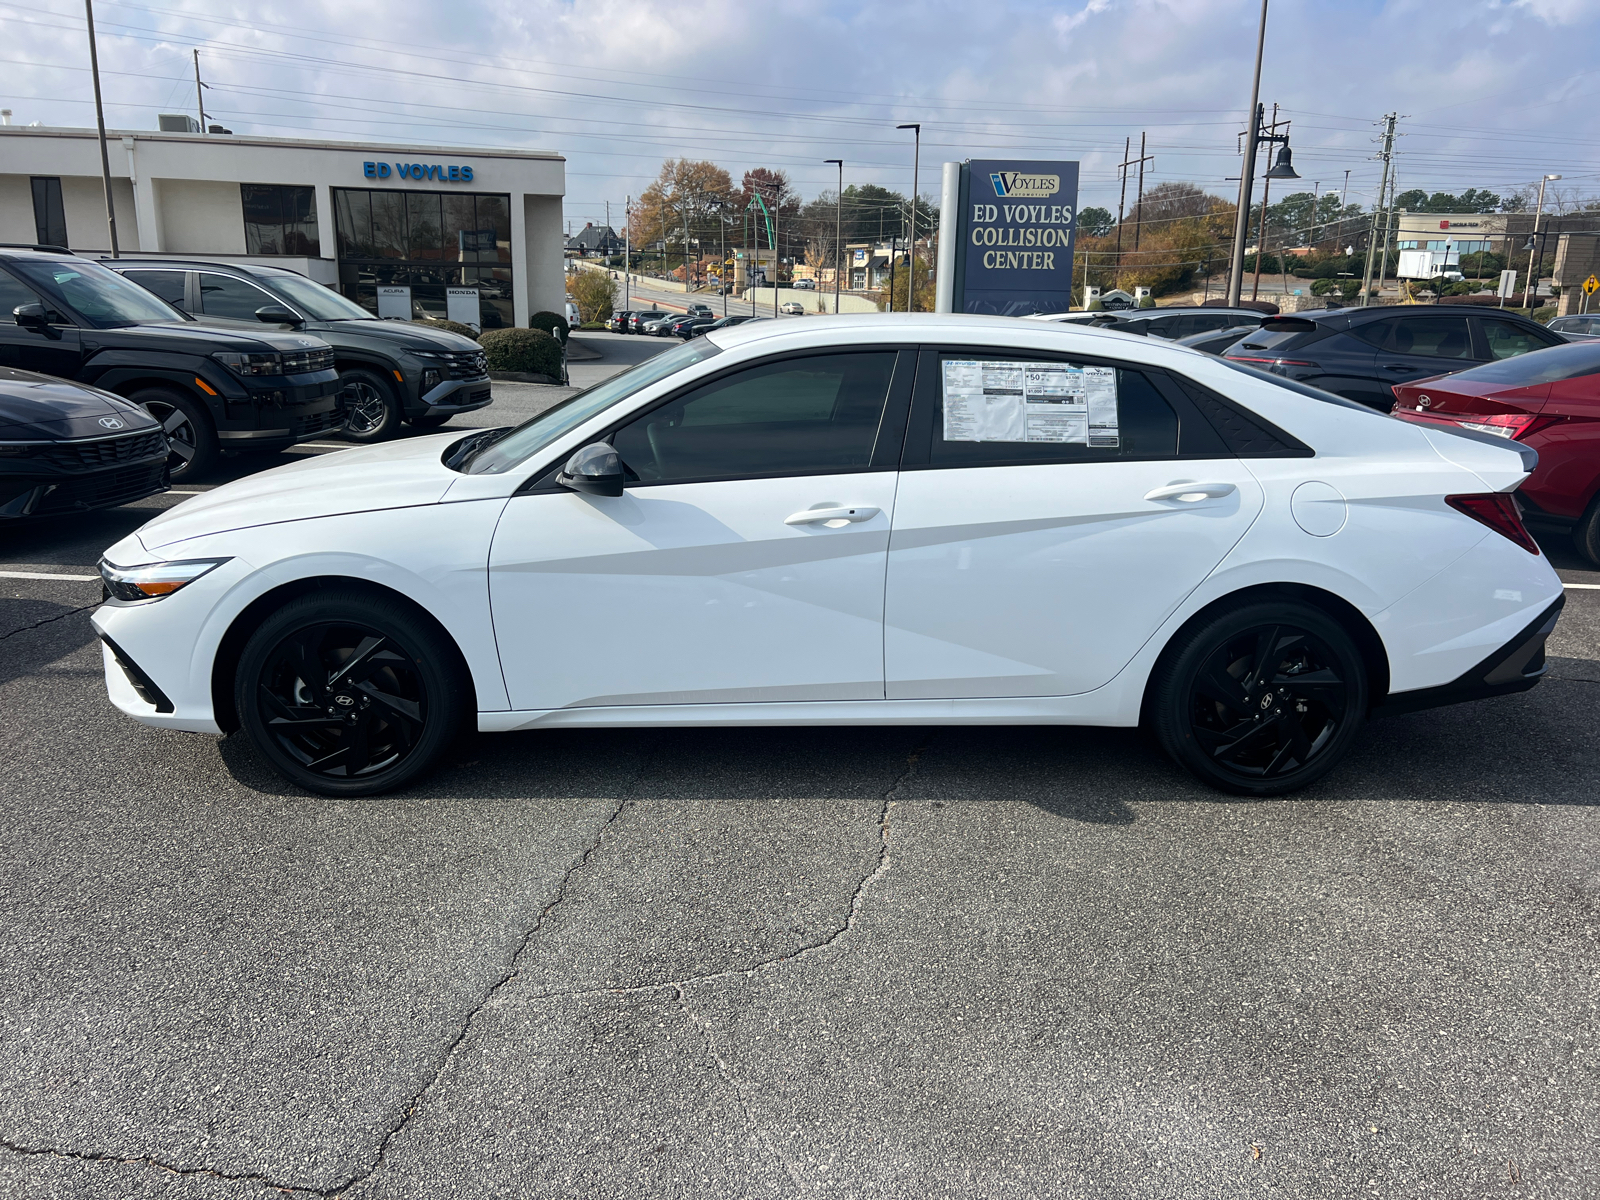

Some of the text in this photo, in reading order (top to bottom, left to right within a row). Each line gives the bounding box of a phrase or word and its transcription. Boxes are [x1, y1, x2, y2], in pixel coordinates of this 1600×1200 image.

[363, 161, 474, 181] ED VOYLES
[1000, 173, 1055, 194] VOYLES
[973, 204, 1072, 224] ED VOYLES
[972, 227, 1071, 247] COLLISION
[983, 250, 1055, 270] CENTER
[1030, 373, 1040, 381] 50
